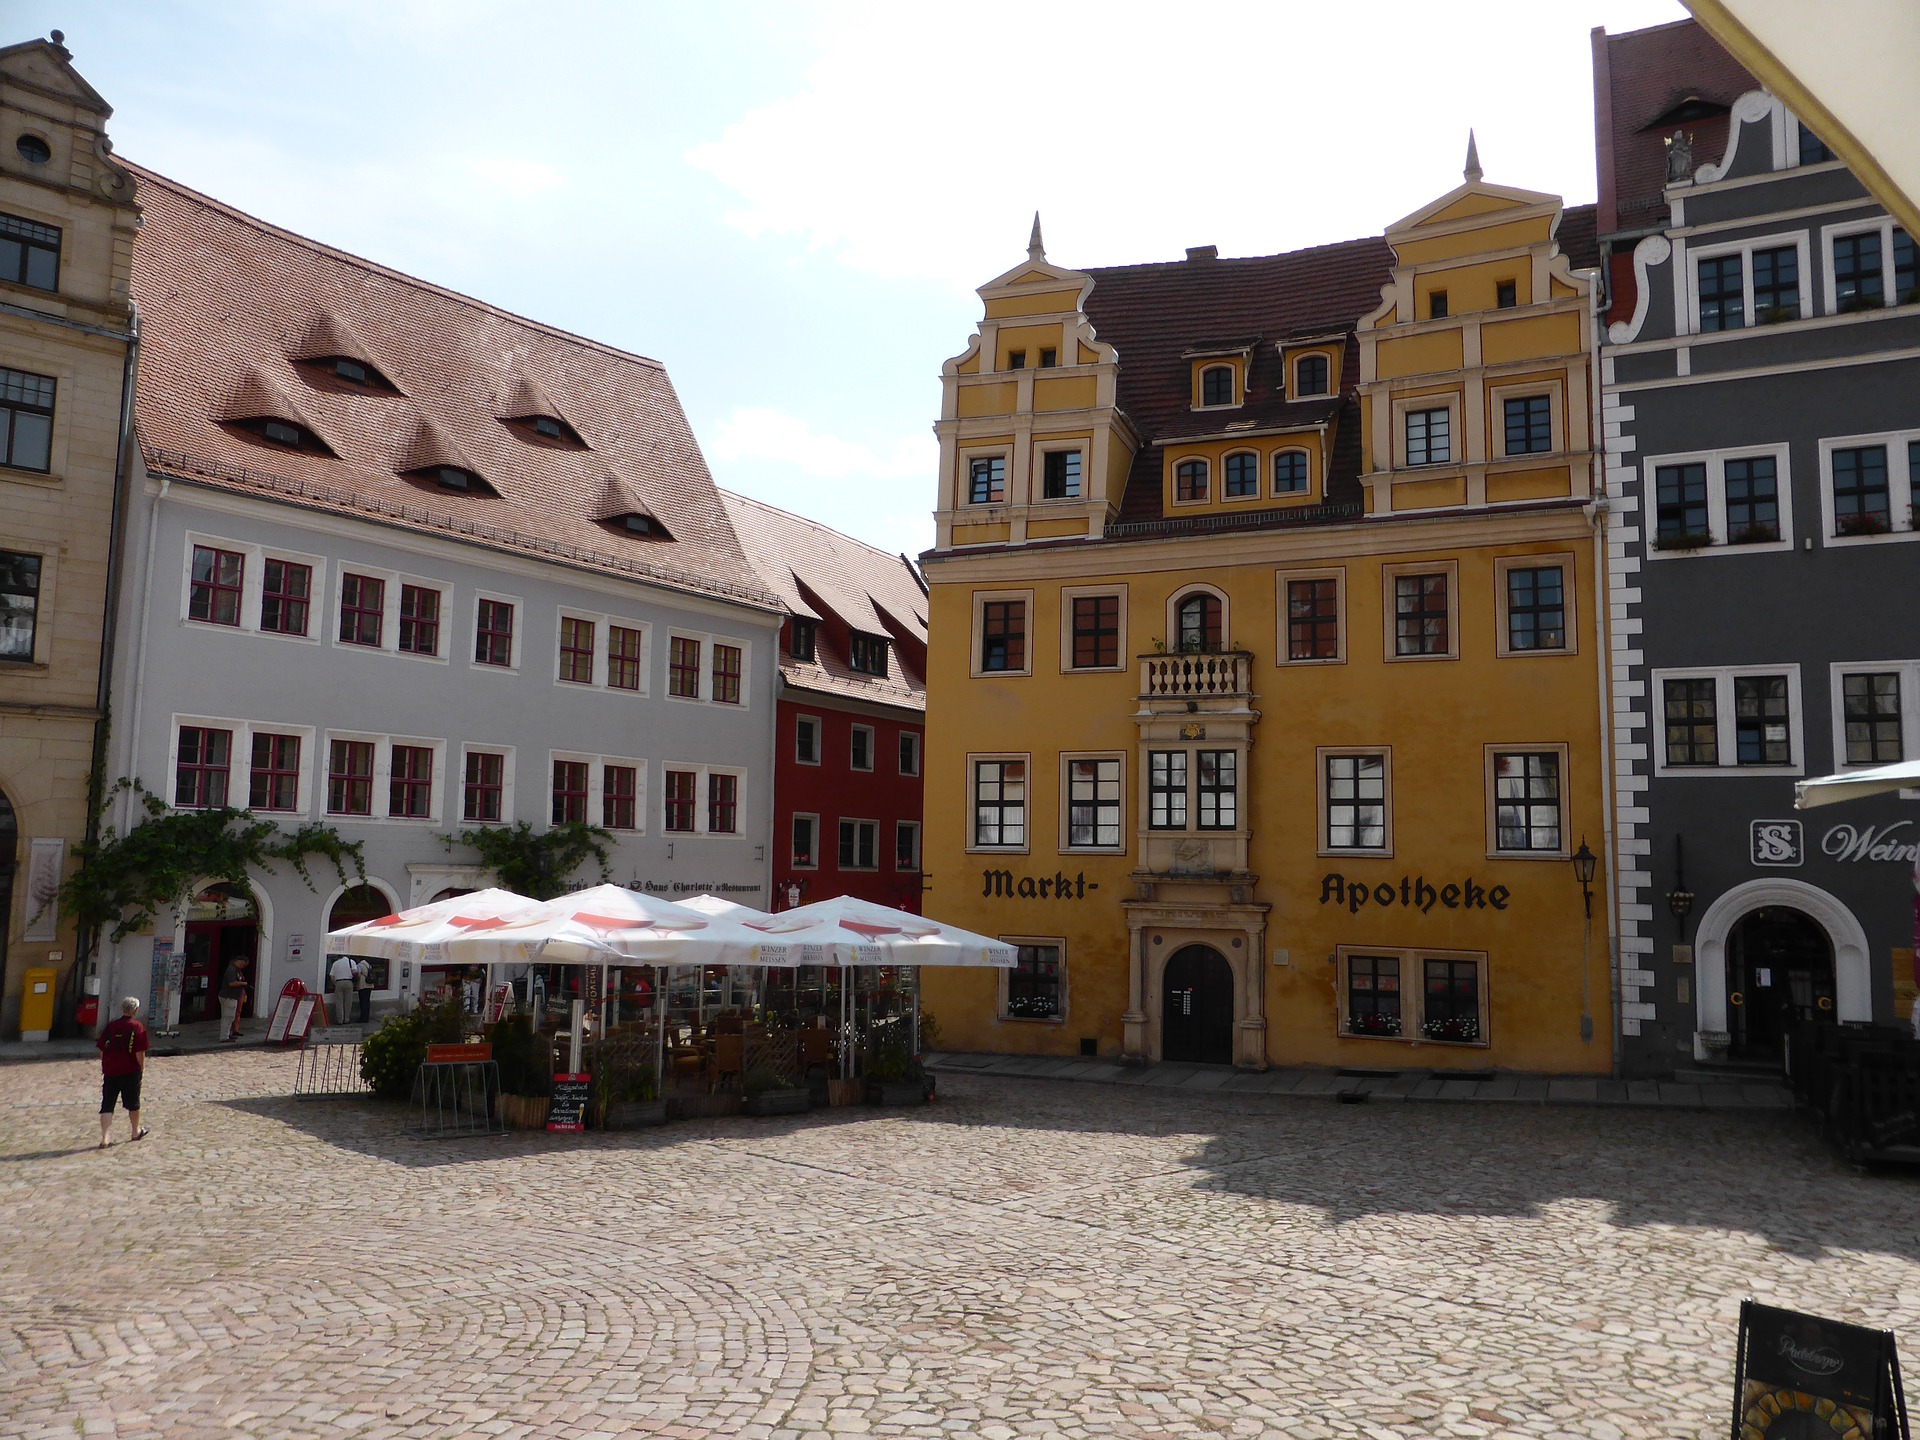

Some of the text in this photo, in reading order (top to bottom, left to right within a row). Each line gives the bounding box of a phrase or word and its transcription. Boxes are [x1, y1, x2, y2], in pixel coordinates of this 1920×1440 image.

[645, 880, 669, 892] Haus
[721, 882, 761, 892] Restaurant
[982, 868, 1099, 899] Markt-
[1319, 873, 1510, 915] Apotheke
[760, 944, 787, 953] WINZER
[760, 955, 787, 964] MEISSEN
